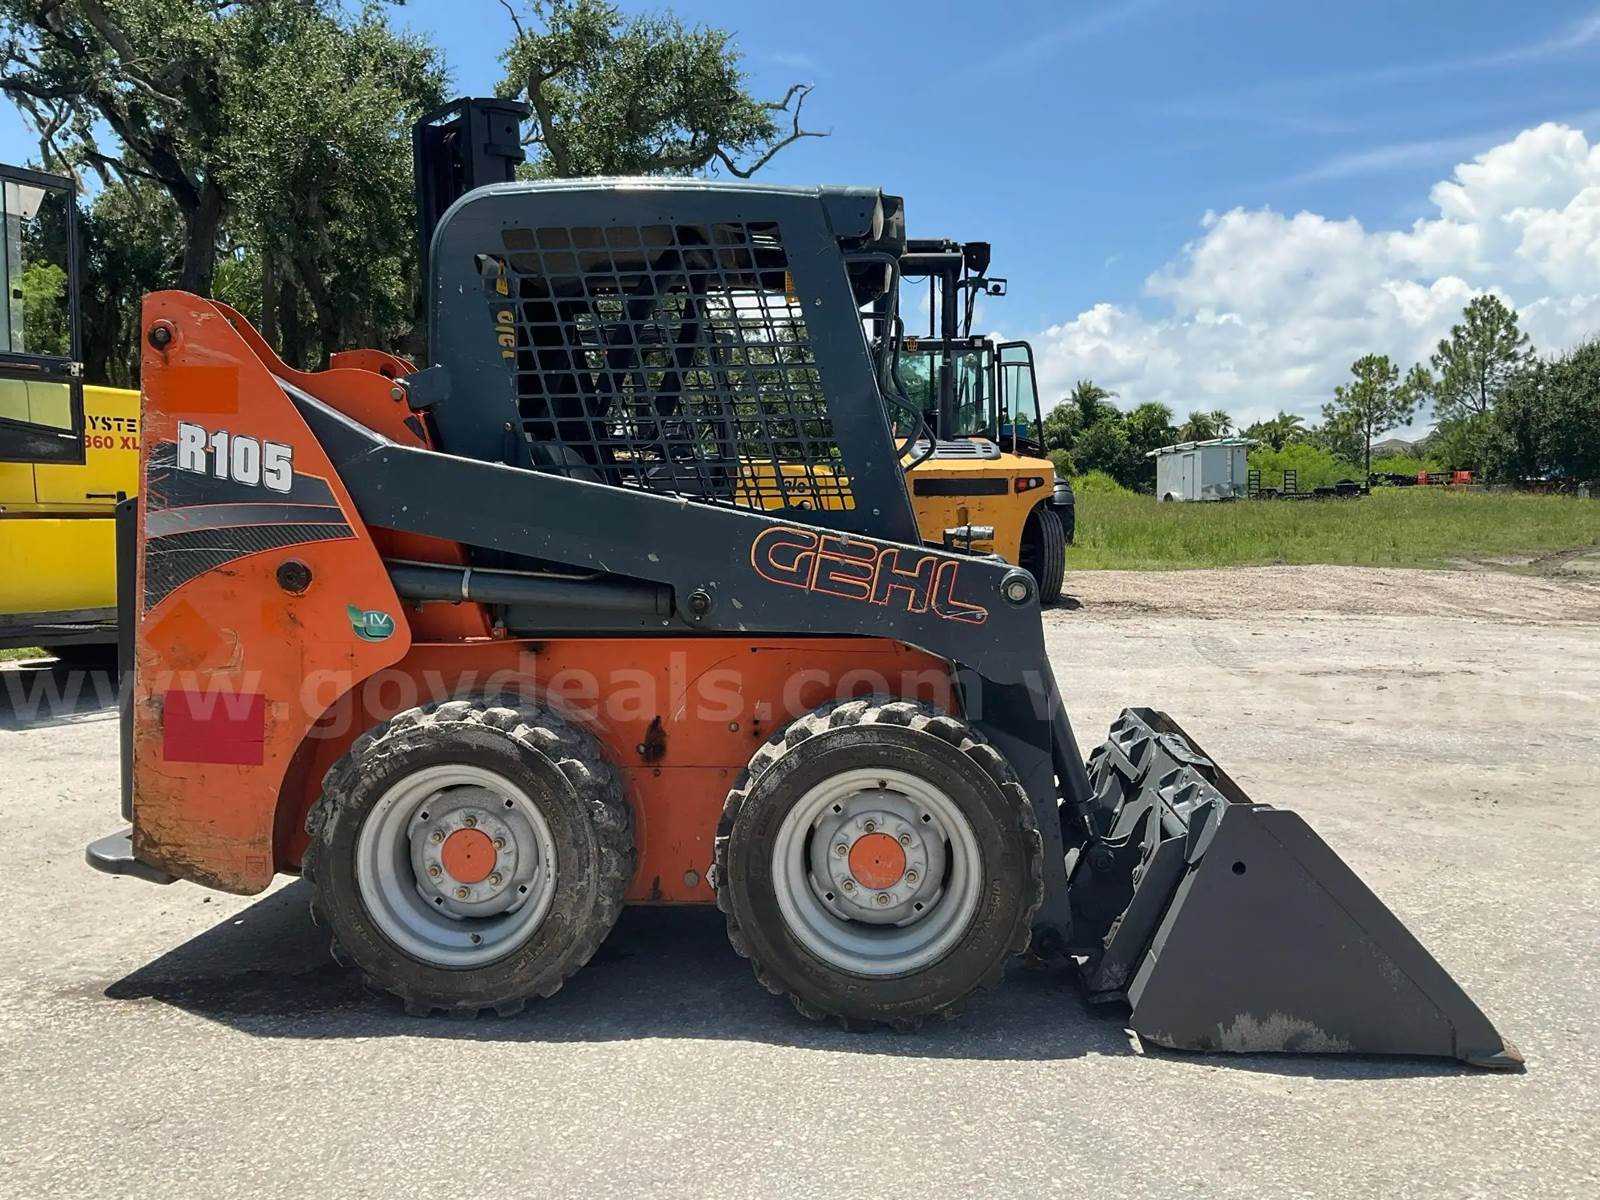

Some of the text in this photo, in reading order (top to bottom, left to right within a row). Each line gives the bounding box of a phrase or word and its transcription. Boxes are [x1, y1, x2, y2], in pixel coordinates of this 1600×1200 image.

[88, 415, 137, 432] YSTE
[120, 436, 140, 450] XL
[177, 419, 294, 494] R105
[751, 526, 988, 625] GEHL
